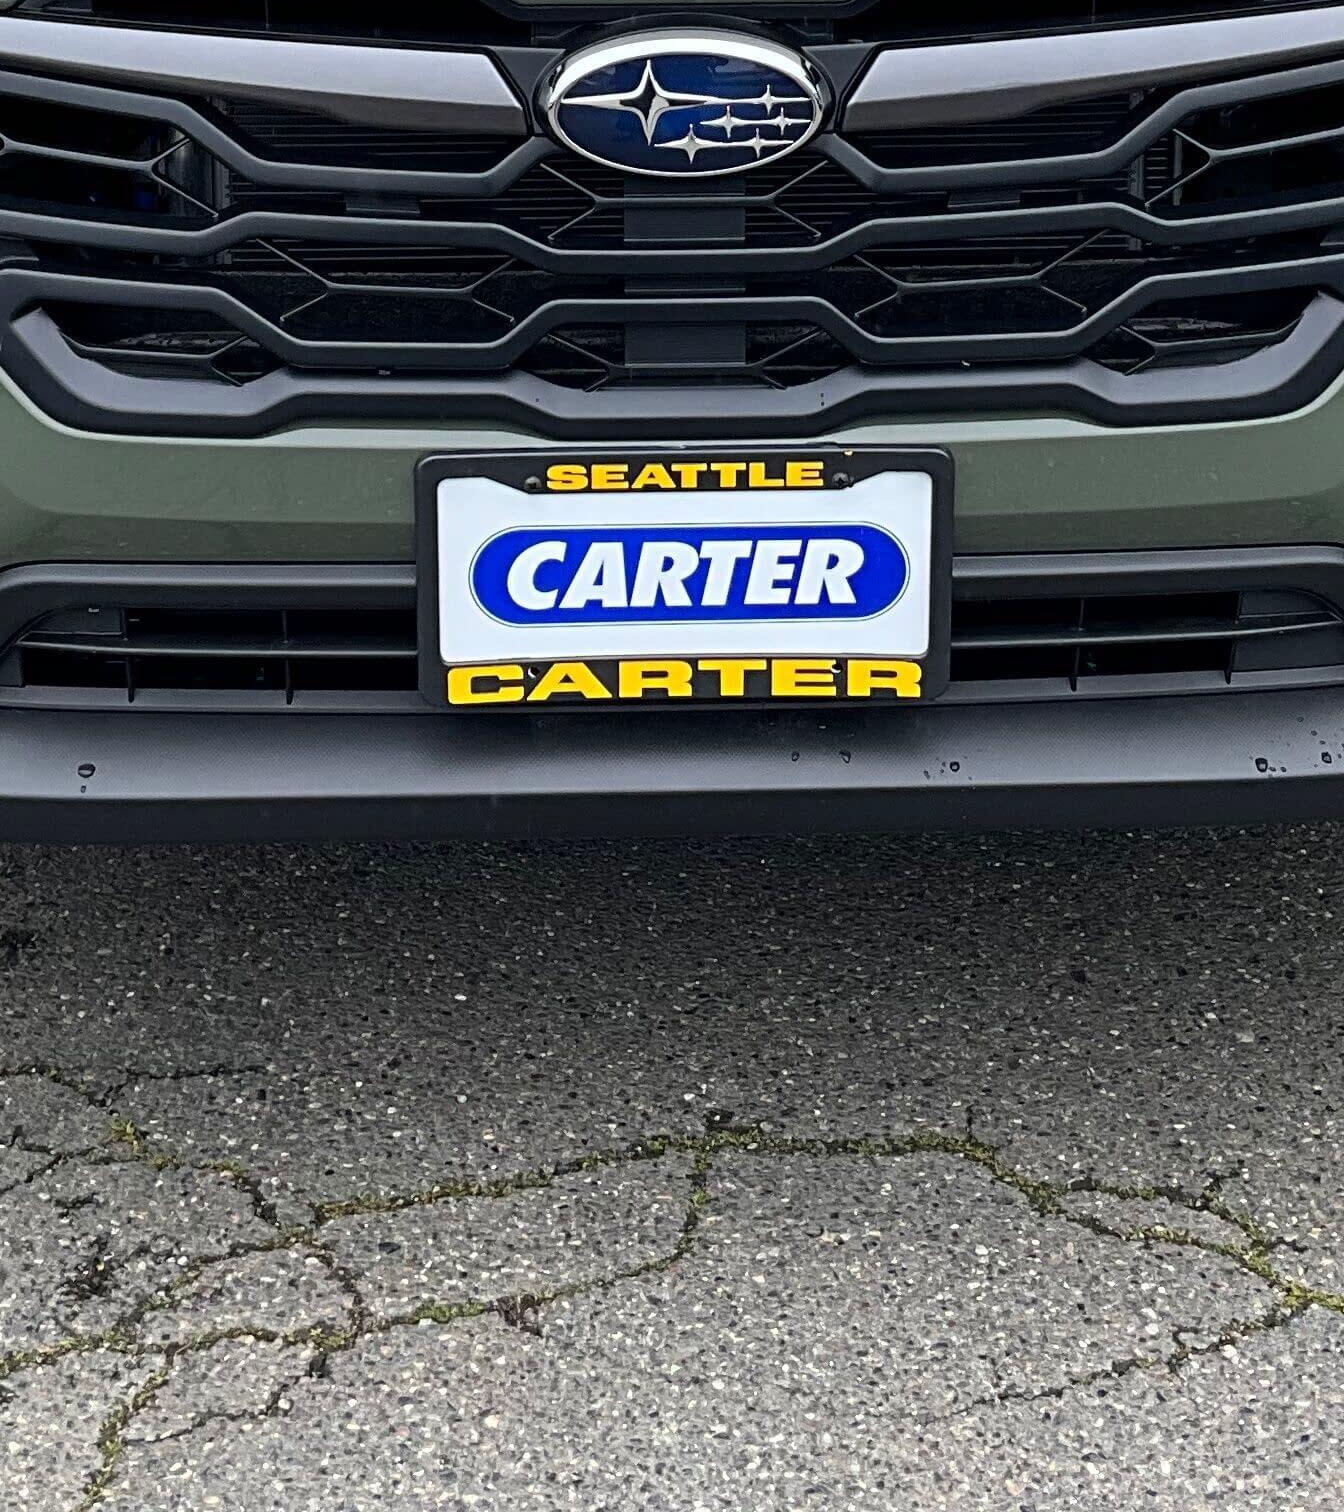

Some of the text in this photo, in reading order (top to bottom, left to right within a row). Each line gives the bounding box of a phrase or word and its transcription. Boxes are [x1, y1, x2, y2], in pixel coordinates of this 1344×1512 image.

[546, 461, 824, 490] SEATTLE
[506, 538, 865, 611] CARTER
[447, 658, 922, 705] CARTER
